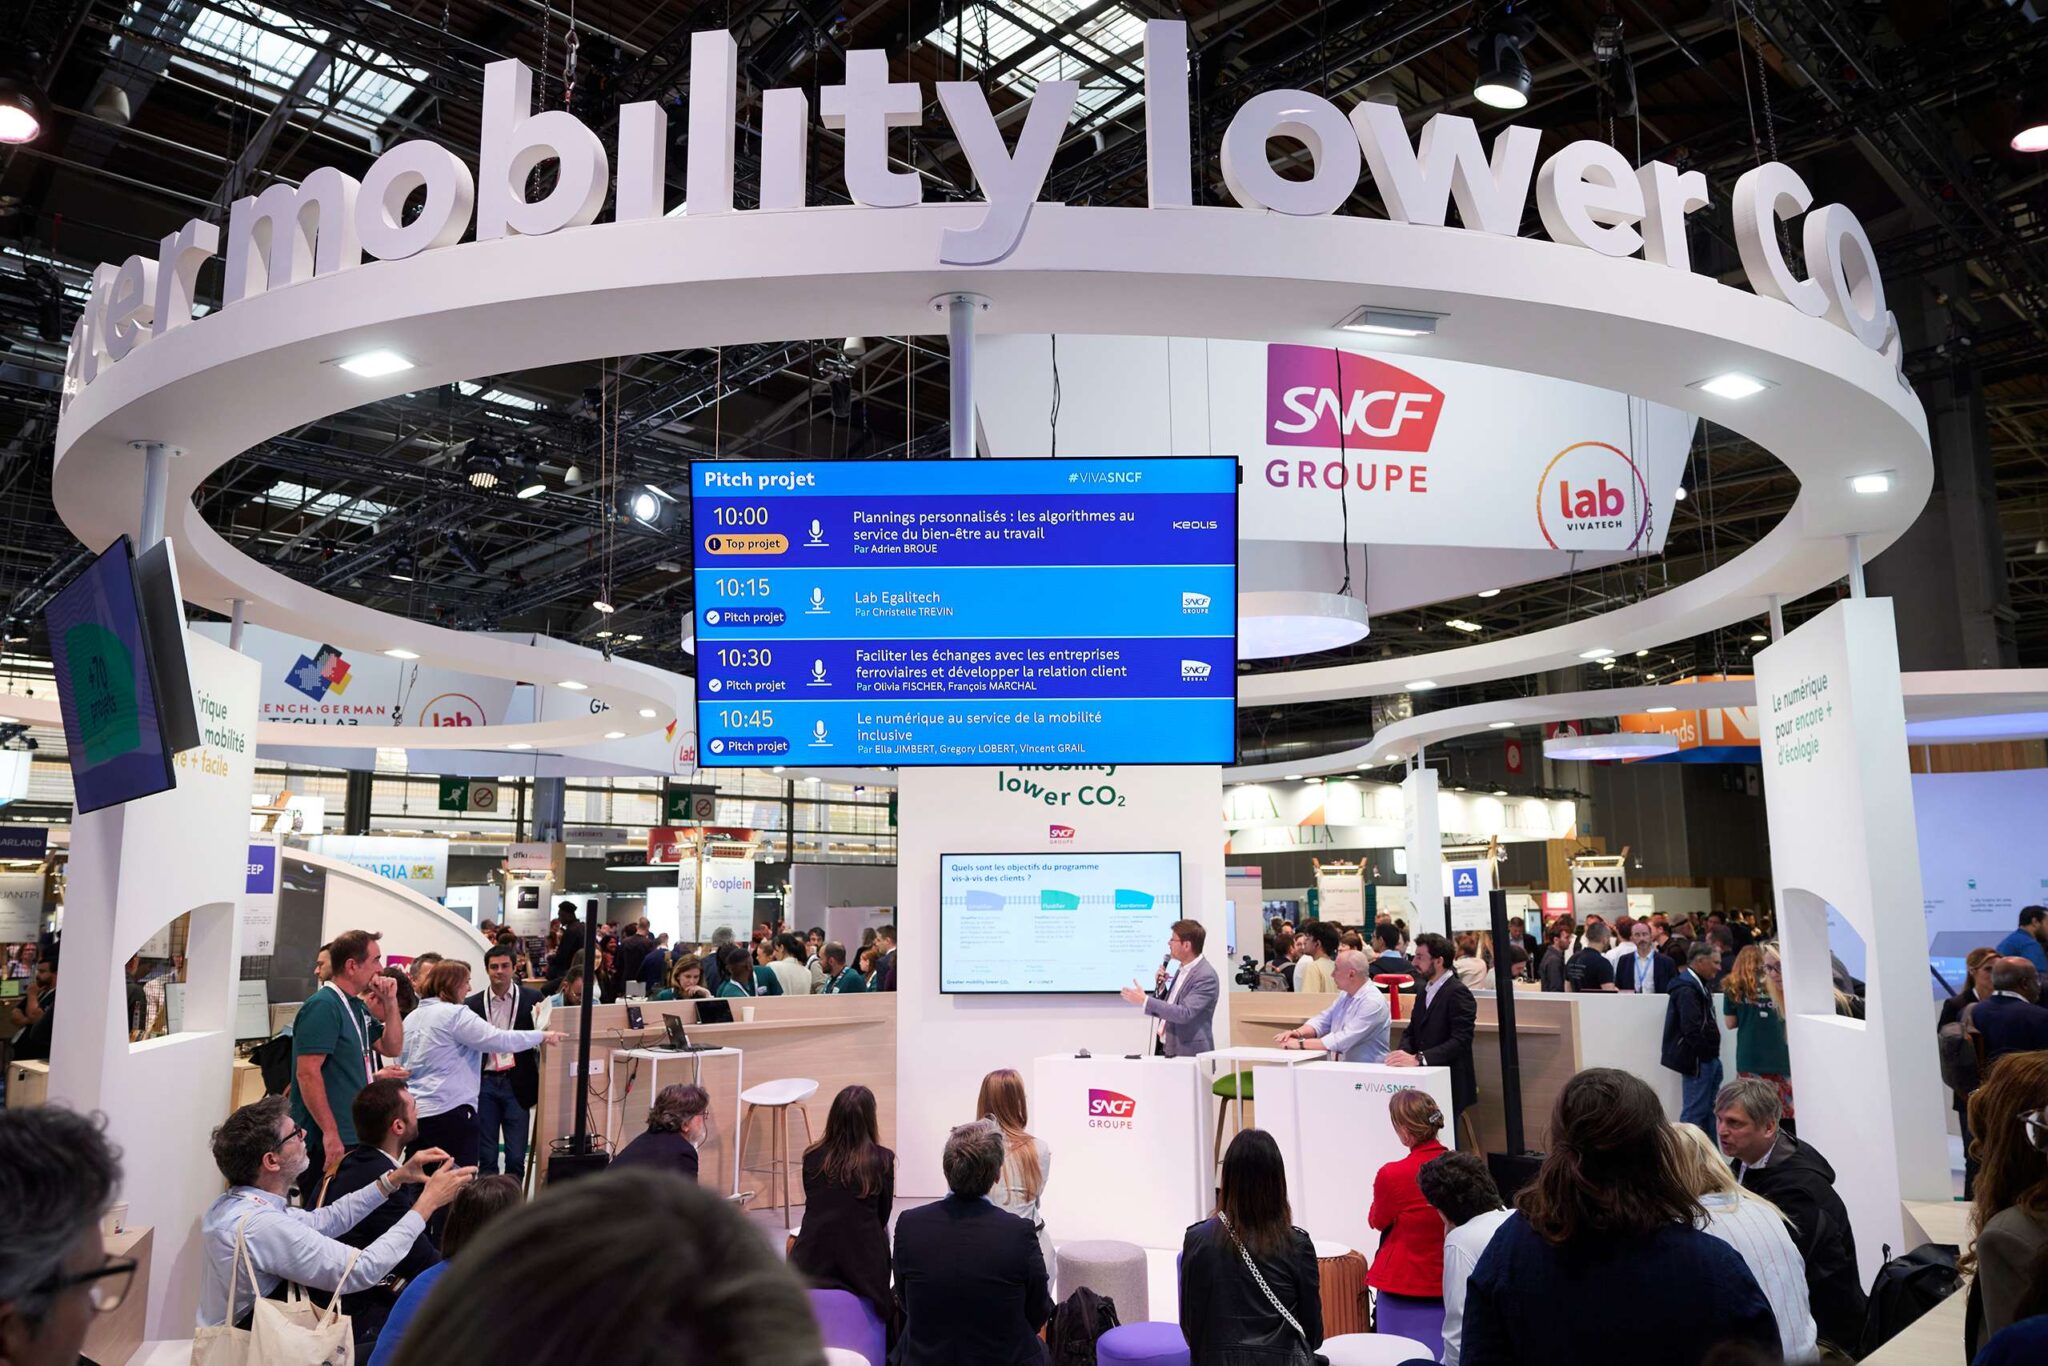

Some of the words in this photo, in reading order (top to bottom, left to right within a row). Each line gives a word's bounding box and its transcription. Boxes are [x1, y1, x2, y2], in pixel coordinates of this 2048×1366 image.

[223, 29, 1079, 306] mobility
[1143, 19, 1709, 272] lower
[1274, 386, 1432, 438] SNCF
[704, 471, 752, 487] Pitch
[758, 471, 816, 490] projet
[1068, 472, 1143, 483] #VIVASNCF
[1265, 459, 1428, 493] GROUPE
[1560, 479, 1625, 519] lab
[713, 507, 769, 526] 10:00
[853, 511, 916, 525] Plannings
[919, 510, 1007, 525] personnalisés
[1017, 510, 1036, 522] les
[1039, 510, 1116, 525] algorithmes
[1119, 512, 1135, 521] au
[1567, 520, 1623, 531] VIVATECH
[853, 528, 899, 540] service
[901, 528, 918, 540] du
[922, 528, 981, 540] bien-être
[984, 529, 1000, 540] au
[1004, 527, 1045, 540] travail
[725, 538, 745, 551] Top
[748, 538, 781, 550] projet
[854, 544, 869, 554] Par
[871, 544, 901, 553] Adrien
[903, 544, 938, 553] BROUE
[715, 578, 771, 597] 10:15
[855, 592, 878, 604] Lab
[882, 591, 941, 605] Egalitech
[1183, 598, 1209, 606] SNCF
[724, 612, 750, 622] Pitch
[753, 612, 784, 624] projet
[854, 607, 870, 617] Par
[872, 606, 916, 617] Christelle
[918, 606, 954, 616] TREVIN
[717, 648, 773, 667] 10:30
[856, 650, 907, 662] Faciliter
[910, 650, 928, 661] les
[932, 648, 991, 664] échanges
[994, 651, 1024, 661] avec
[1027, 648, 1045, 660] les
[1048, 648, 1120, 662] entreprises
[856, 667, 928, 678] ferroviaires
[931, 668, 945, 678] et
[948, 666, 1020, 680] développer
[1022, 666, 1034, 677] la
[1038, 665, 1087, 677] relation
[1091, 664, 1128, 676] client
[1182, 666, 1210, 674] SNCF
[726, 680, 752, 690] Pitch
[755, 680, 786, 692] projet
[856, 682, 872, 692] Par
[874, 682, 900, 692] Olivia
[902, 682, 946, 692] FISCHER,
[948, 681, 987, 692] François
[989, 682, 1038, 691] MARCHAL
[1772, 694, 1782, 712] Le
[1783, 674, 1828, 709] numérique
[719, 710, 774, 728] 10:45
[857, 713, 872, 724] Le
[876, 712, 944, 726] numérique
[948, 714, 963, 724] au
[966, 712, 1010, 724] service
[1014, 712, 1030, 724] de
[1034, 712, 1045, 723] la
[1049, 711, 1102, 724] mobilité
[1775, 719, 1793, 746] pour
[1795, 706, 1824, 732] encore
[204, 726, 245, 753] mobilité
[857, 730, 913, 740] inclusive
[728, 741, 754, 752] Pitch
[756, 741, 788, 754] projet
[858, 746, 872, 754] Par
[875, 745, 892, 754] Ella
[894, 744, 938, 755] JIMBERT,
[940, 744, 976, 756] Gregory
[978, 744, 1018, 755] LOBERT,
[1020, 744, 1056, 753] Vincent
[1058, 744, 1086, 753] GRAIL
[1778, 734, 1819, 766] d'écologie
[201, 749, 228, 776] facile
[998, 770, 1071, 806] lower
[1050, 830, 1074, 838] SNCF
[0, 838, 42, 848] ARLAND
[951, 864, 974, 873] Quels
[994, 864, 1006, 872] les
[1007, 864, 1041, 874] objectifs
[1042, 864, 1052, 872] du
[1054, 865, 1100, 874] programme
[705, 876, 752, 893] Peoplein
[1576, 876, 1624, 894] XXII
[1090, 1099, 1134, 1114] SNCF
[1088, 1120, 1133, 1130] GROUPE
